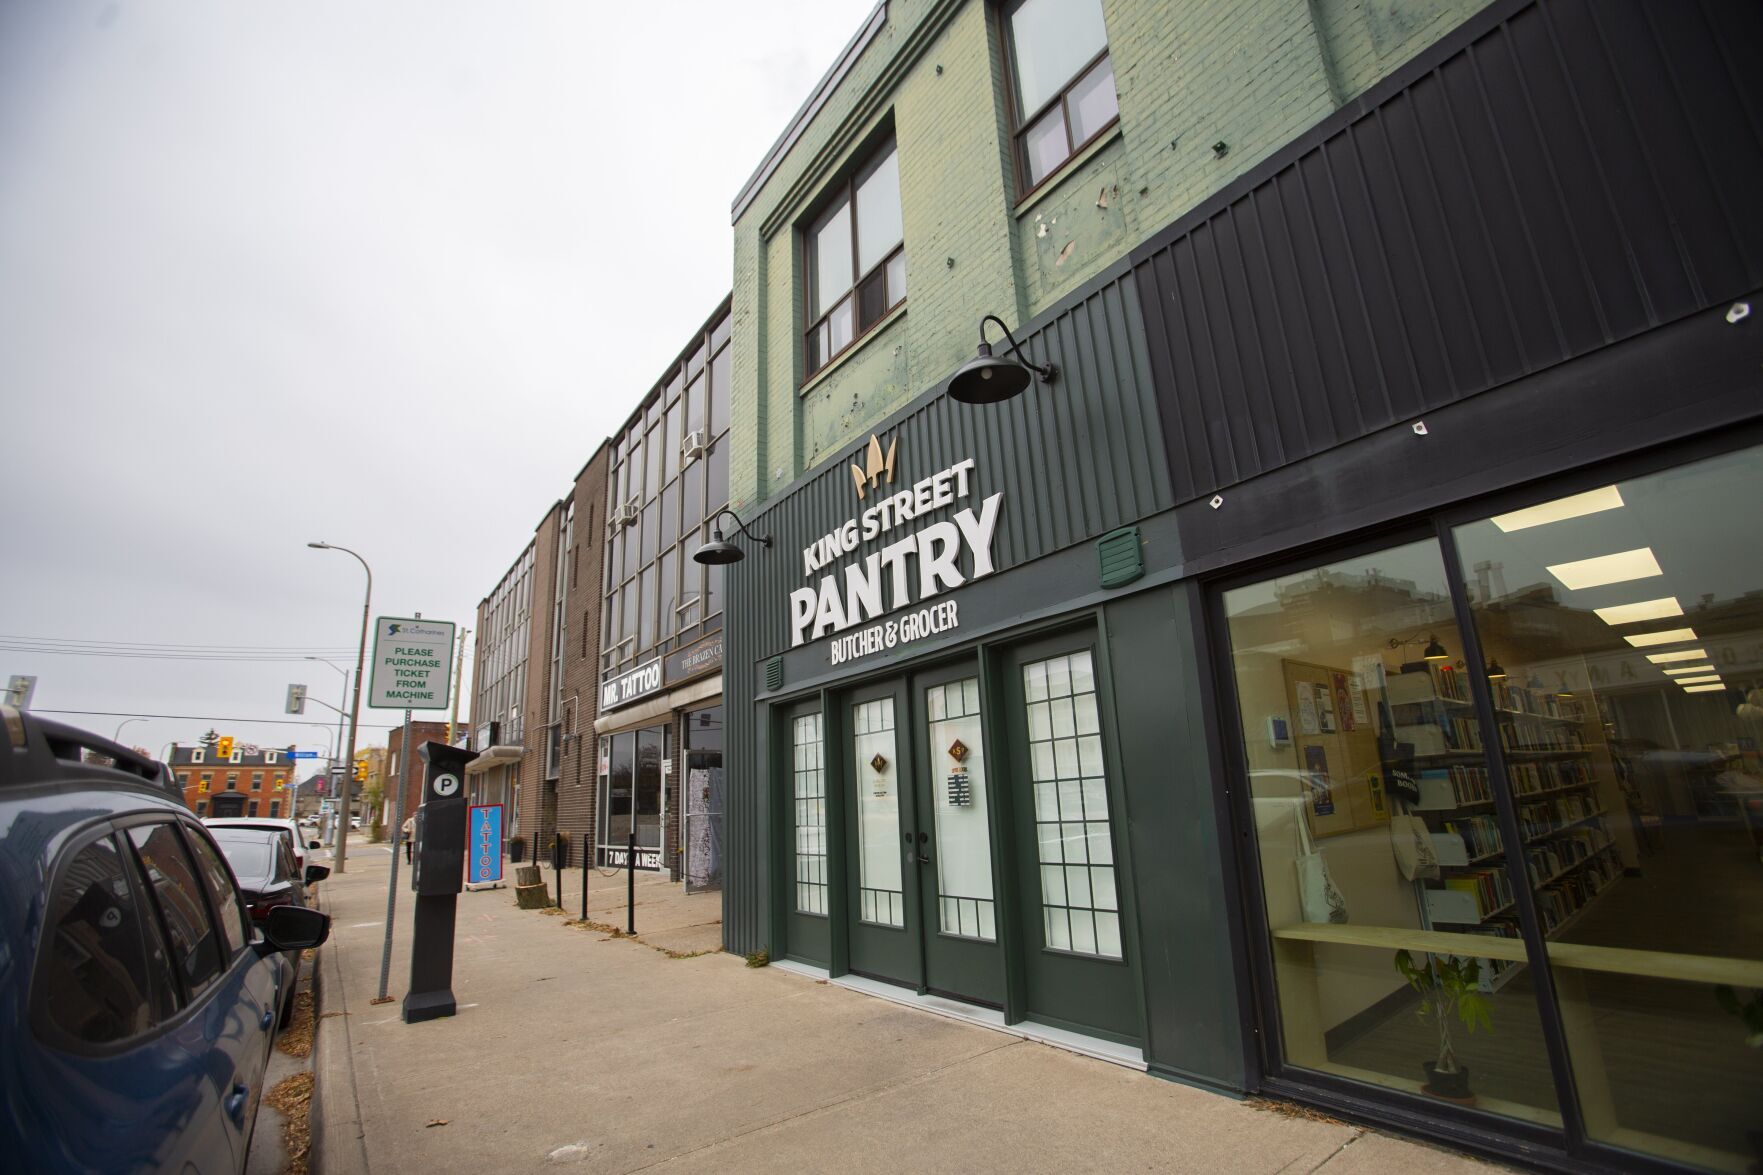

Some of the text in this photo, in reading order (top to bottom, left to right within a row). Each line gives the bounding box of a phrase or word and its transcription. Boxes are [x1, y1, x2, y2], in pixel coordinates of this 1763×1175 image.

[803, 458, 975, 577] KING STREET
[790, 492, 1004, 648] PANTRY
[831, 600, 959, 666] BUTCHER & GROCER
[395, 647, 434, 657] PLEASE
[385, 658, 441, 668] PURCHASE
[682, 657, 692, 670] THE
[394, 669, 431, 678] TICKET
[396, 680, 426, 688] FROM
[603, 663, 659, 707] MR. TATTOO
[386, 691, 435, 700] MACHINE
[441, 778, 453, 792] P
[480, 808, 492, 878] TATTOO
[609, 851, 661, 868] 7 DAY A WEEK
